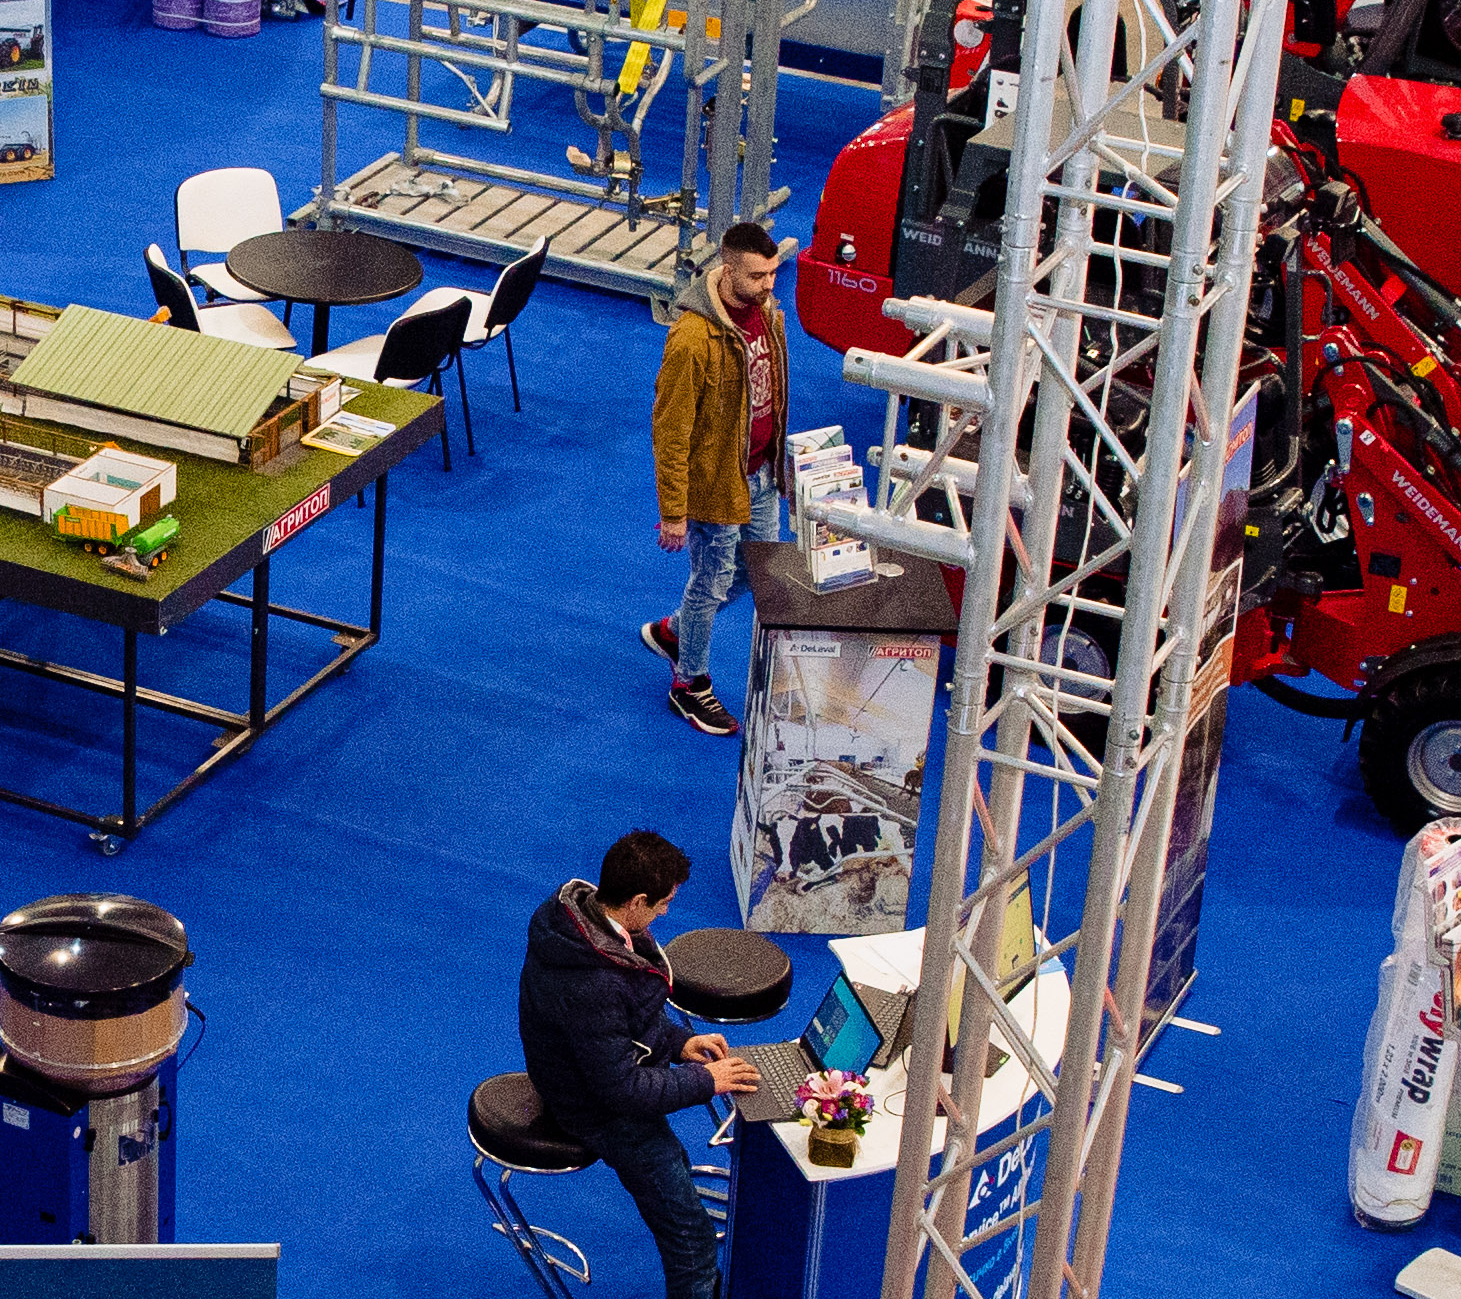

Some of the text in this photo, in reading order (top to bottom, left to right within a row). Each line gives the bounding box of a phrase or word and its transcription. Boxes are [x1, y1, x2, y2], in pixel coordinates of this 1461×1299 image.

[827, 268, 878, 294] 1160
[1305, 234, 1380, 321] WEIDEMANN
[270, 486, 330, 551] АГРИТОП
[877, 645, 932, 658] АГРИТОП
